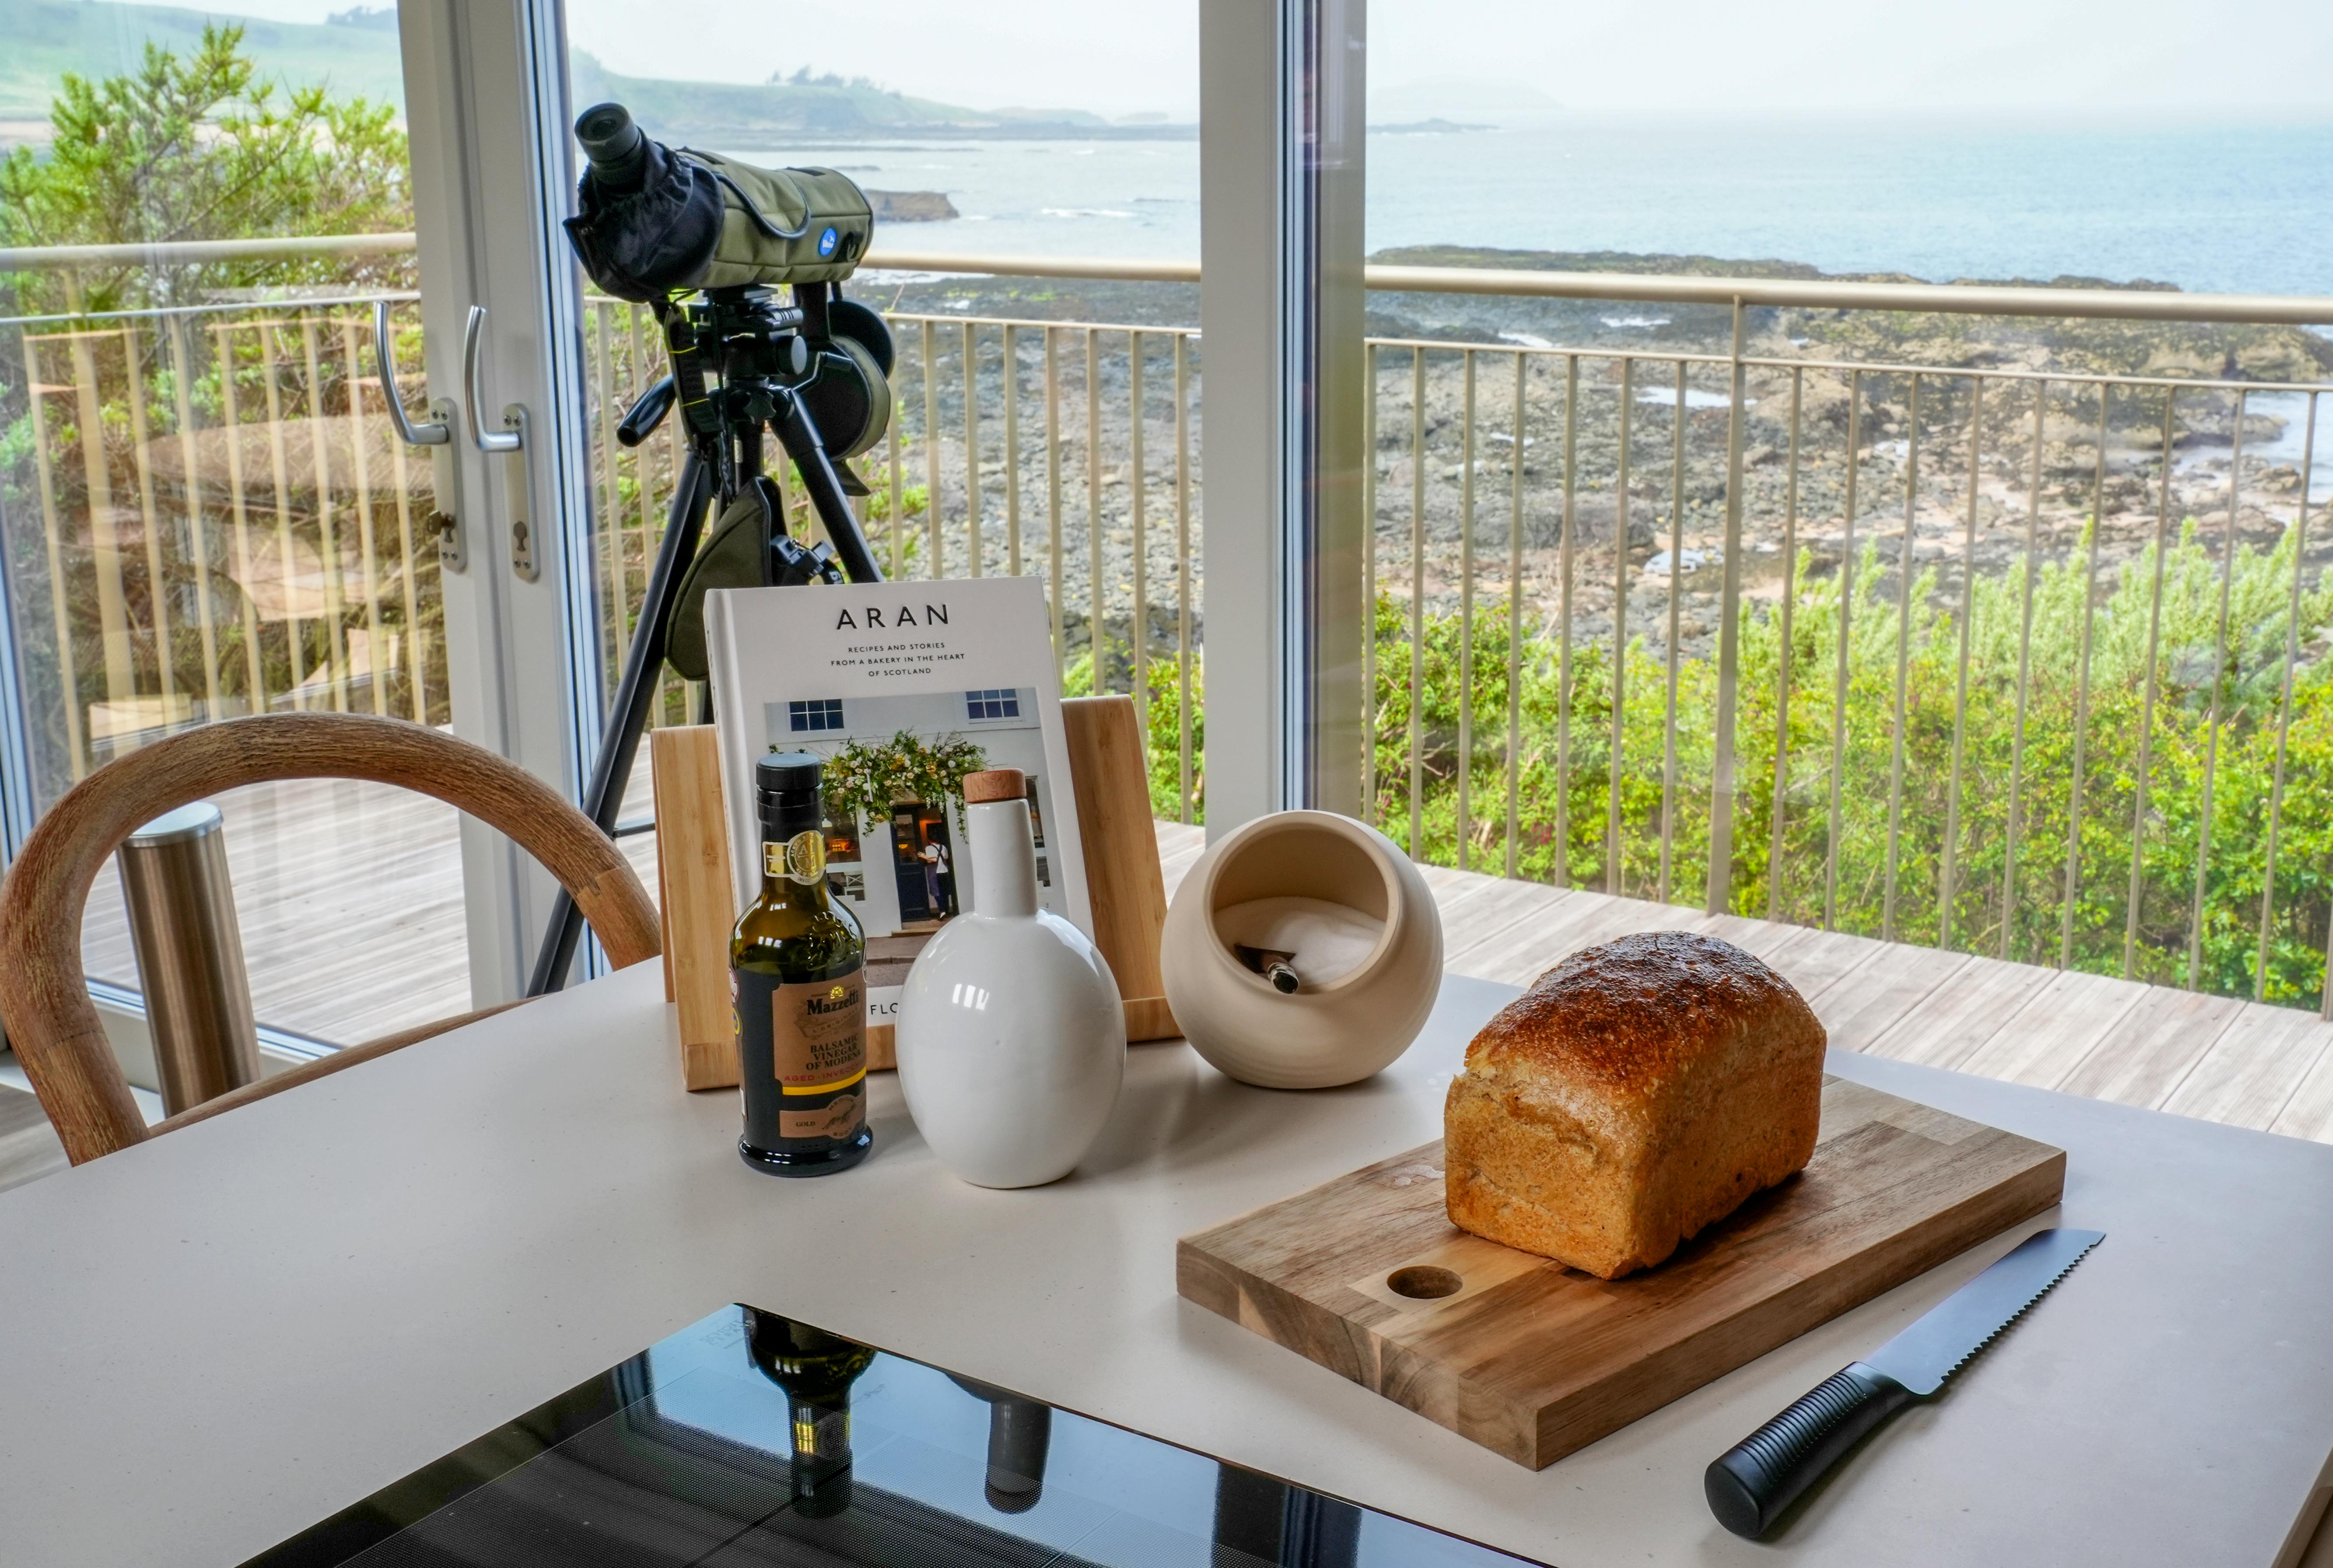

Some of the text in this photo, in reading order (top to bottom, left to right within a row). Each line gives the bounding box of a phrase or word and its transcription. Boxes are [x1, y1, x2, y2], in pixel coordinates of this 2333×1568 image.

[836, 604, 949, 630] ARAN
[883, 668, 931, 676] SCOTLAND
[806, 989, 858, 1015] Mazzetti
[810, 1033, 858, 1053] BALSAMIC
[814, 1043, 858, 1060] VINEGAR
[806, 1049, 861, 1071] OF MODENA
